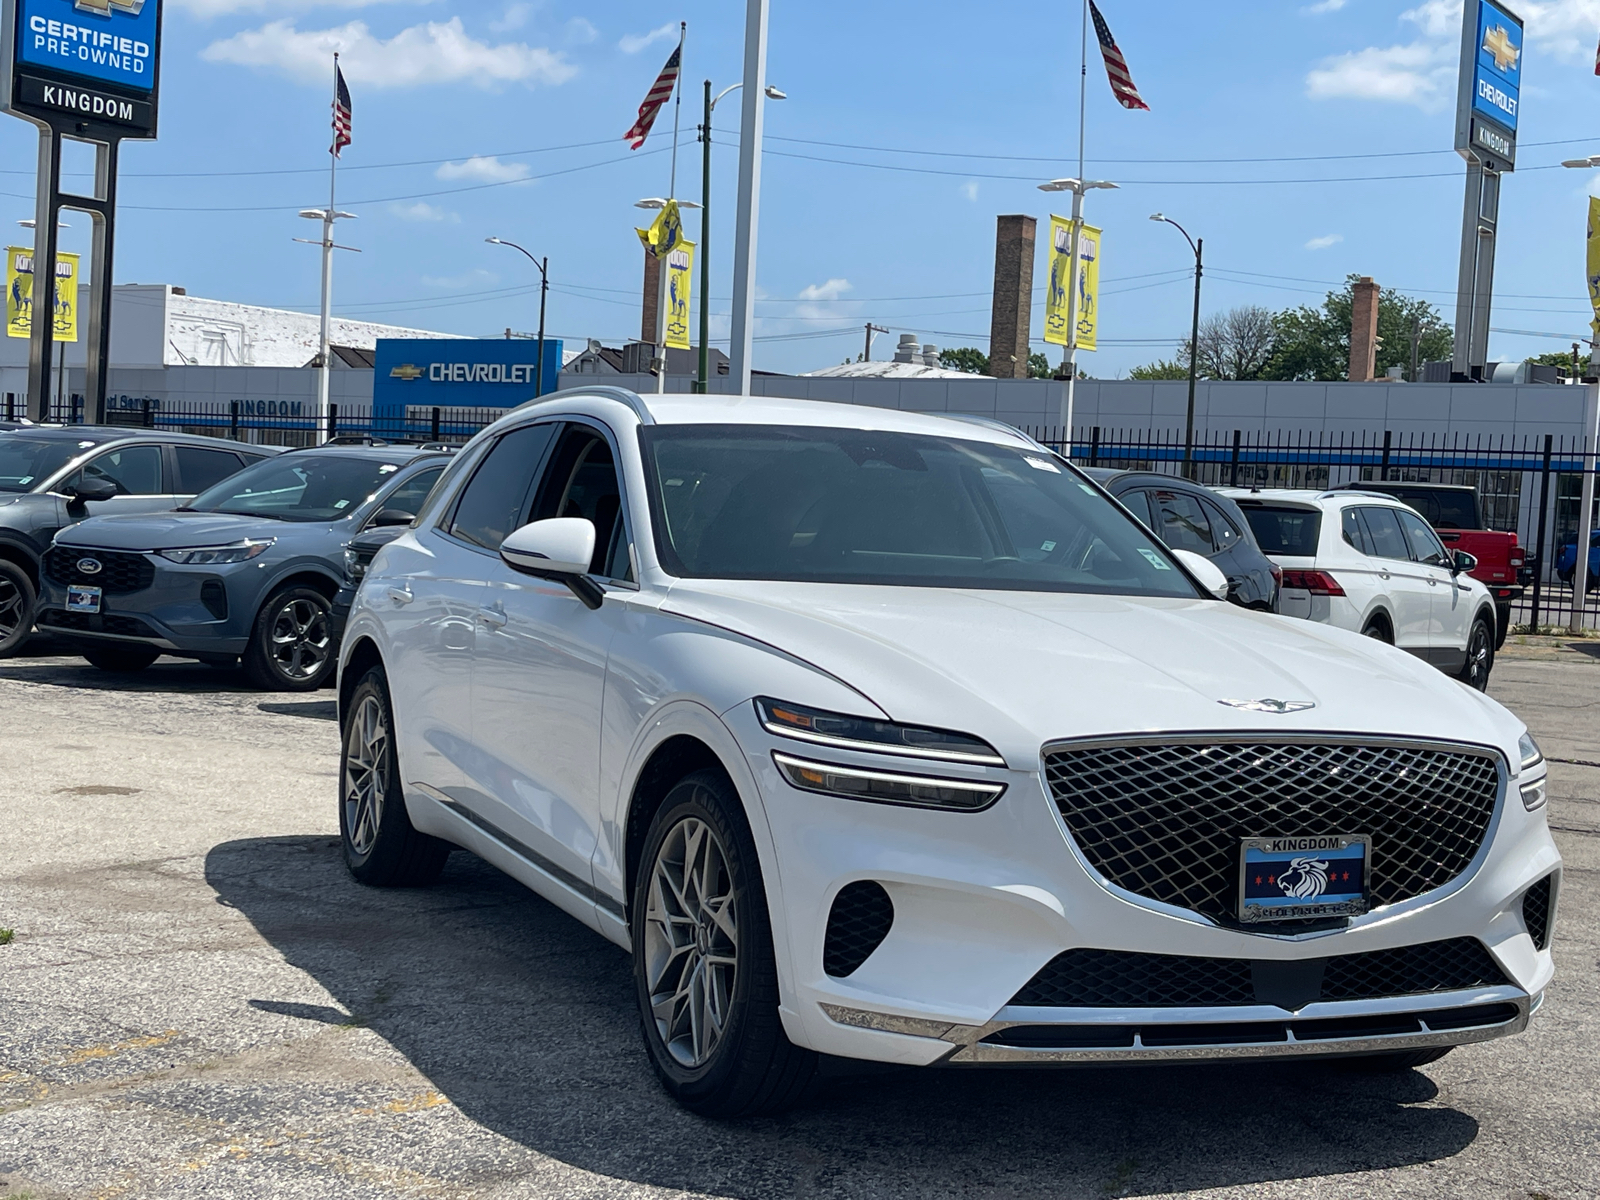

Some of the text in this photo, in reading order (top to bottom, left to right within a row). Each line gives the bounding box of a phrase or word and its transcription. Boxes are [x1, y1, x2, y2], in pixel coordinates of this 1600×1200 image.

[30, 15, 149, 58] CERTIFIED
[34, 34, 144, 74] PRE-OWNED
[43, 85, 133, 121] KINGDOM
[1478, 79, 1518, 116] CHEVROLET
[1479, 126, 1509, 156] KINGDOM
[429, 363, 535, 384] CHEVROLET
[1272, 837, 1339, 852] KINGDOM
